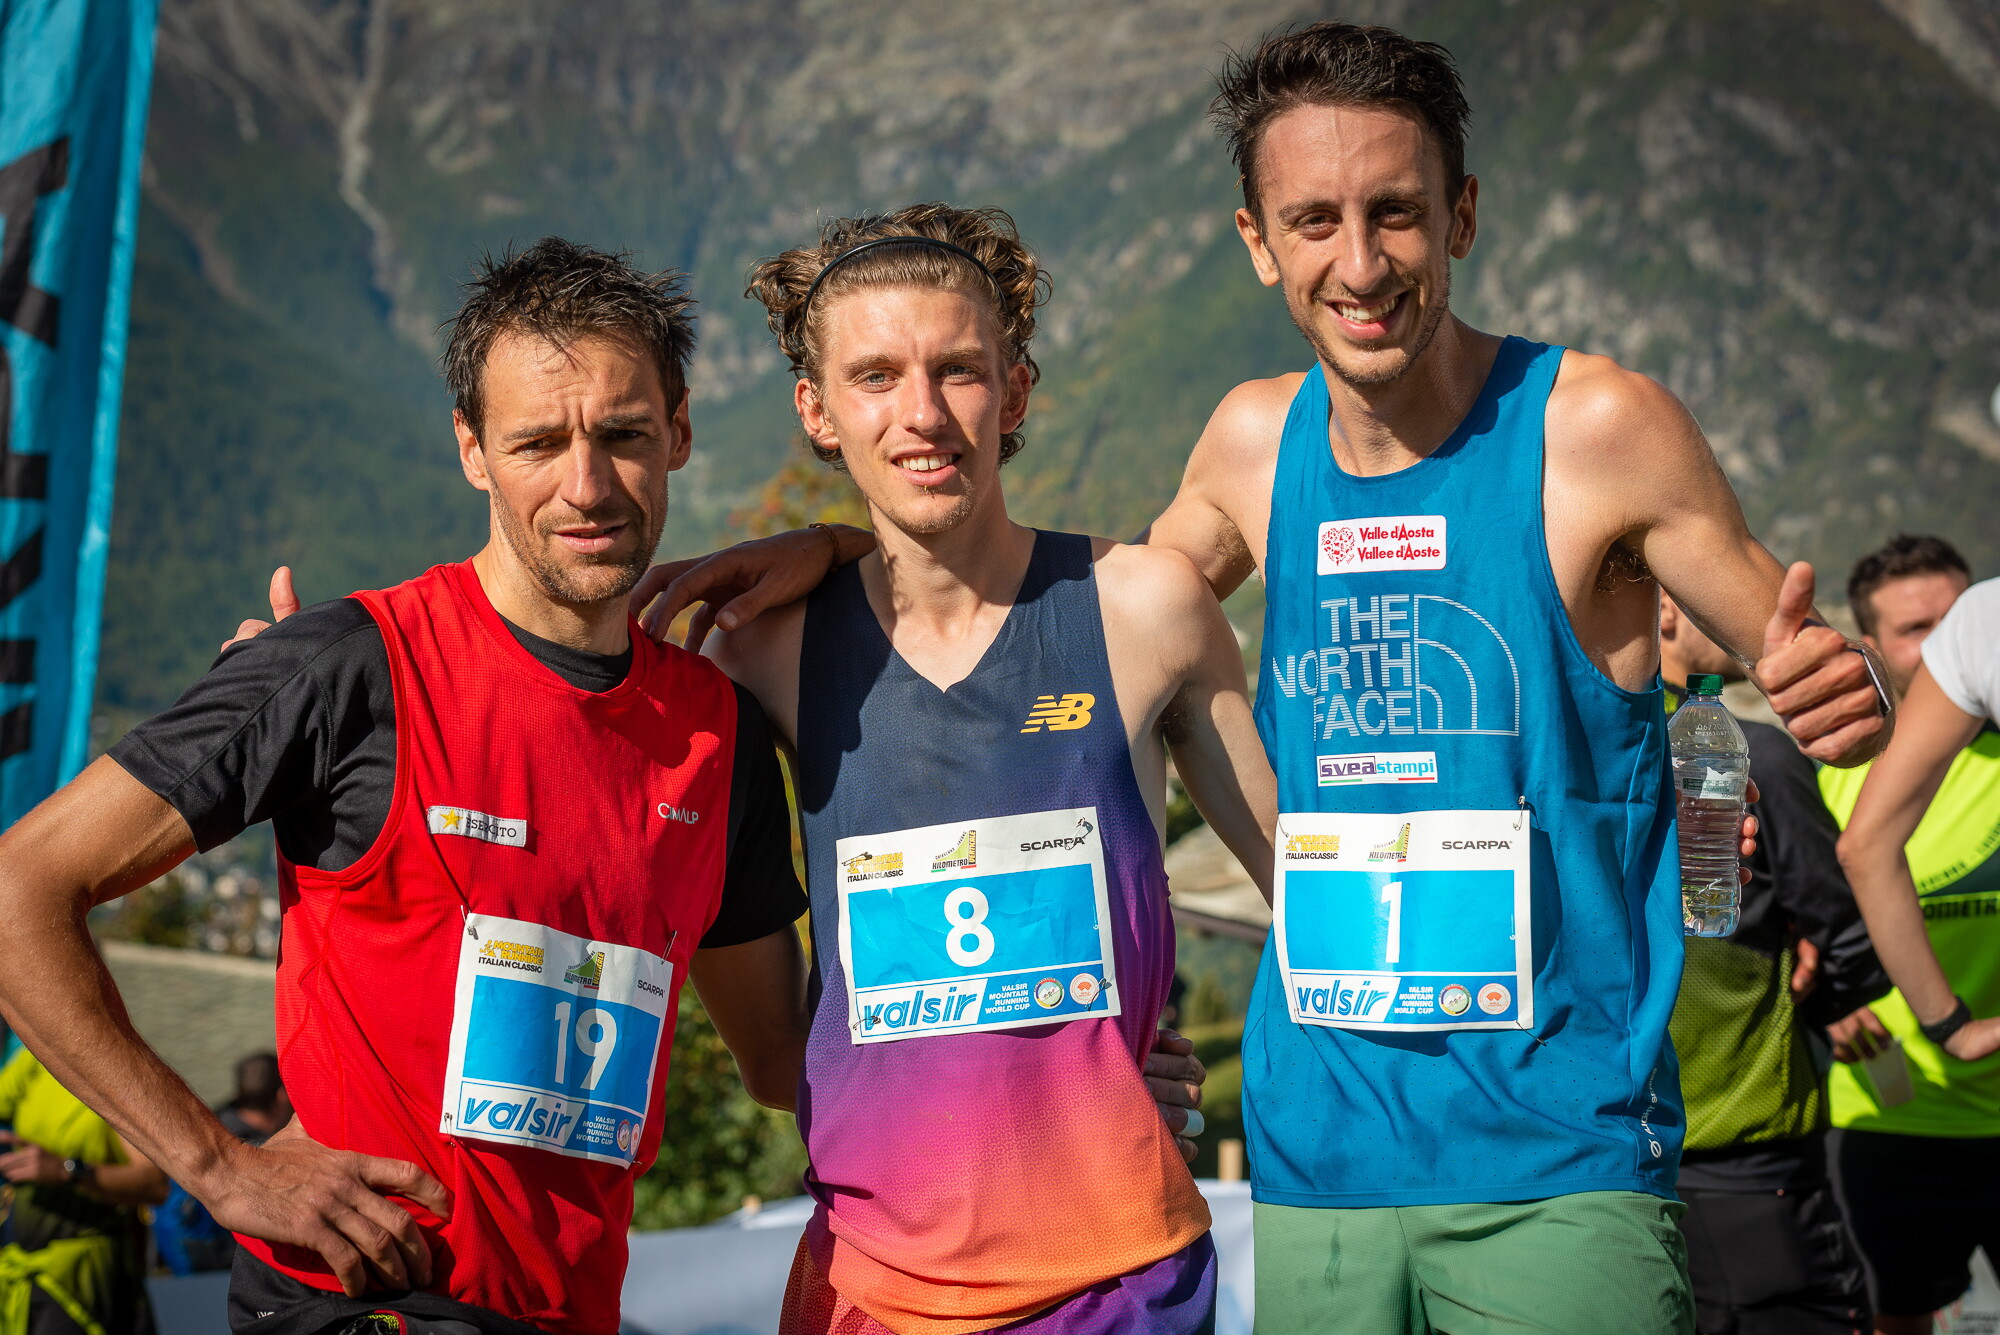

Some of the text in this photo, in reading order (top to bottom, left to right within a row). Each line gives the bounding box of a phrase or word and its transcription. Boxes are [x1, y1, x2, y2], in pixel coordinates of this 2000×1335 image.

[1358, 523, 1435, 542] Valle d'Aosta
[1357, 543, 1440, 563] Vallee d'Aoste
[1320, 593, 1411, 643] THE
[1272, 642, 1413, 698] NORTH
[1020, 693, 1096, 734] NB
[1313, 690, 1415, 742] FACE
[466, 816, 517, 838] ESERCITO
[1294, 834, 1340, 844] MOUNTAIN
[1300, 843, 1340, 852] RUNNING
[932, 858, 968, 870] KILOMETRO
[1285, 852, 1339, 860] ITALIAN CLASSIC
[862, 861, 904, 874] RUNNING
[847, 869, 904, 883] ITALIAN CLASSIC
[944, 886, 996, 968] 8
[1381, 881, 1403, 964] 1
[493, 940, 545, 958] MOUNTAIN
[478, 956, 543, 974] ITALIAN CLASSIC
[500, 951, 544, 966] RUNNING
[989, 989, 1029, 1000] MOUNTAIN
[1001, 983, 1028, 992] VALSIR
[995, 996, 1029, 1007] RUNNING
[1297, 979, 1390, 1017] valsir
[863, 986, 977, 1032] valsir
[985, 1003, 1030, 1014] WORLD CUP
[553, 1001, 617, 1091] 19
[463, 1096, 573, 1139] valsir
[595, 1115, 616, 1125] VALSIR
[582, 1121, 615, 1132] MOUNTAIN
[586, 1128, 614, 1139] RUNNING
[576, 1134, 613, 1146] WORLD CUP
